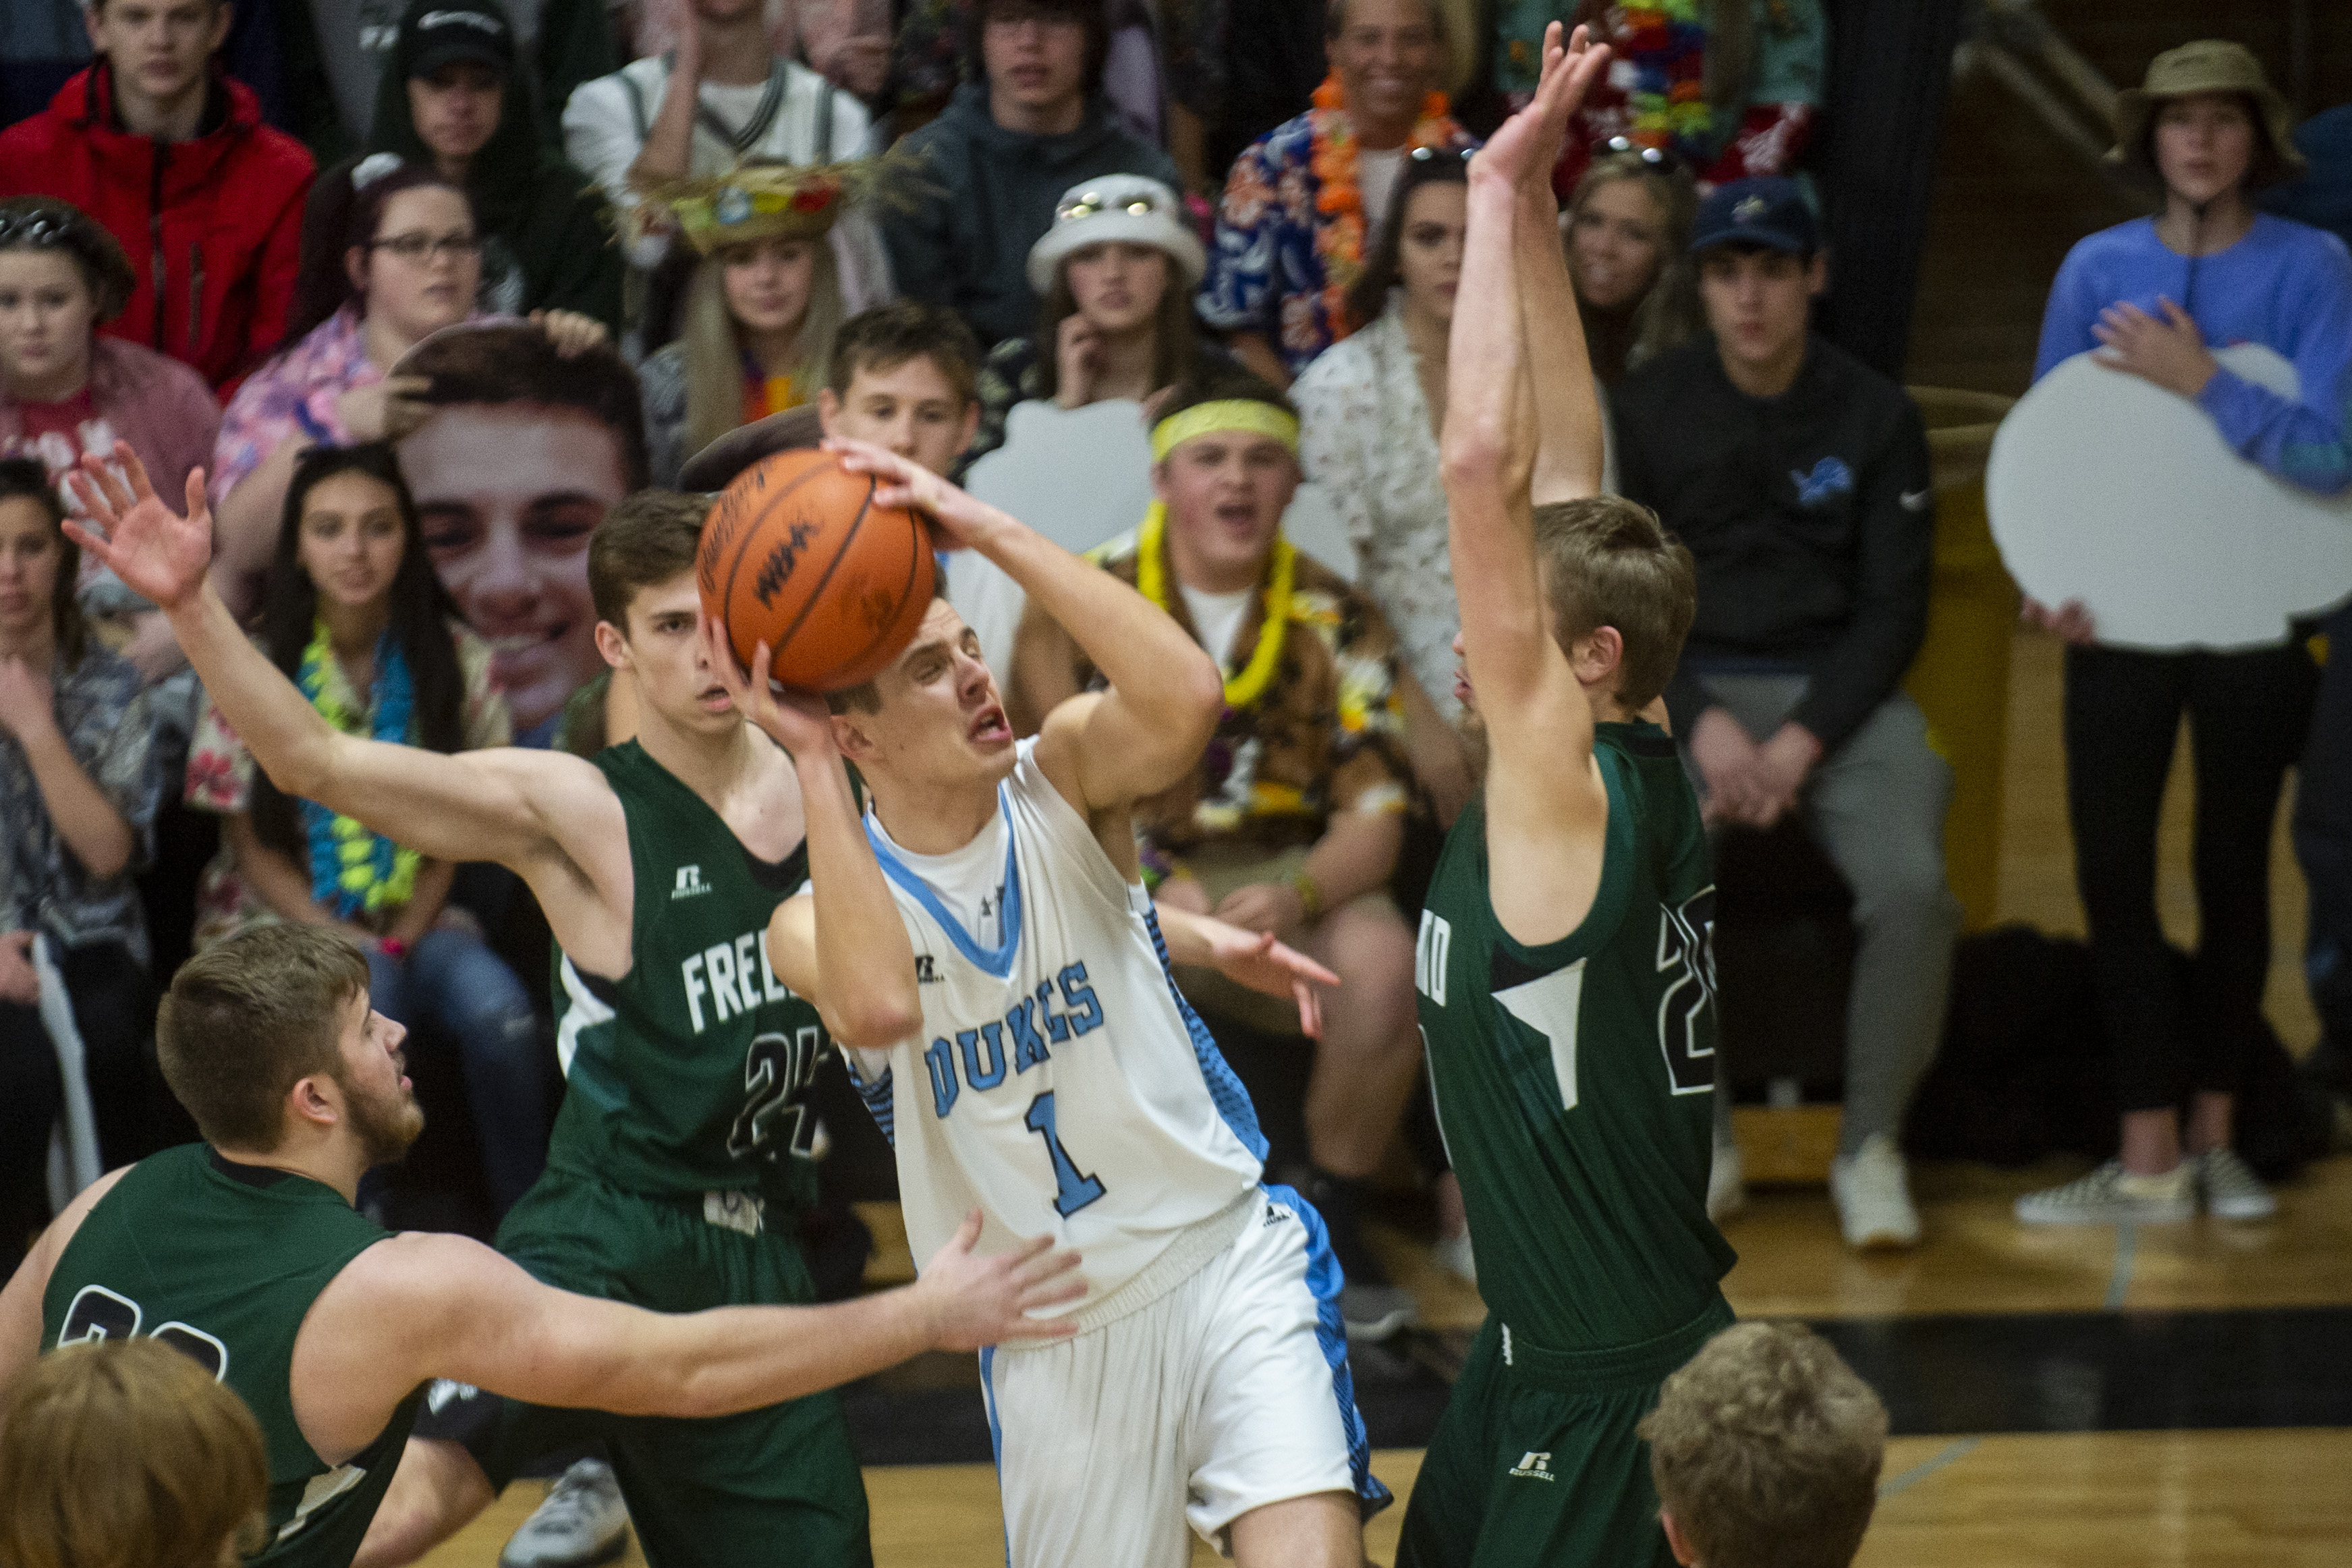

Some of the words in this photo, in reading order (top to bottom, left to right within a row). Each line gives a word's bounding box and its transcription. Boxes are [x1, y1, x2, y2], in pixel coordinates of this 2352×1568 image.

[924, 960, 1104, 1119] DUKES
[1024, 1089, 1107, 1221] 1
[1508, 1467, 1555, 1482] RUSSELL
